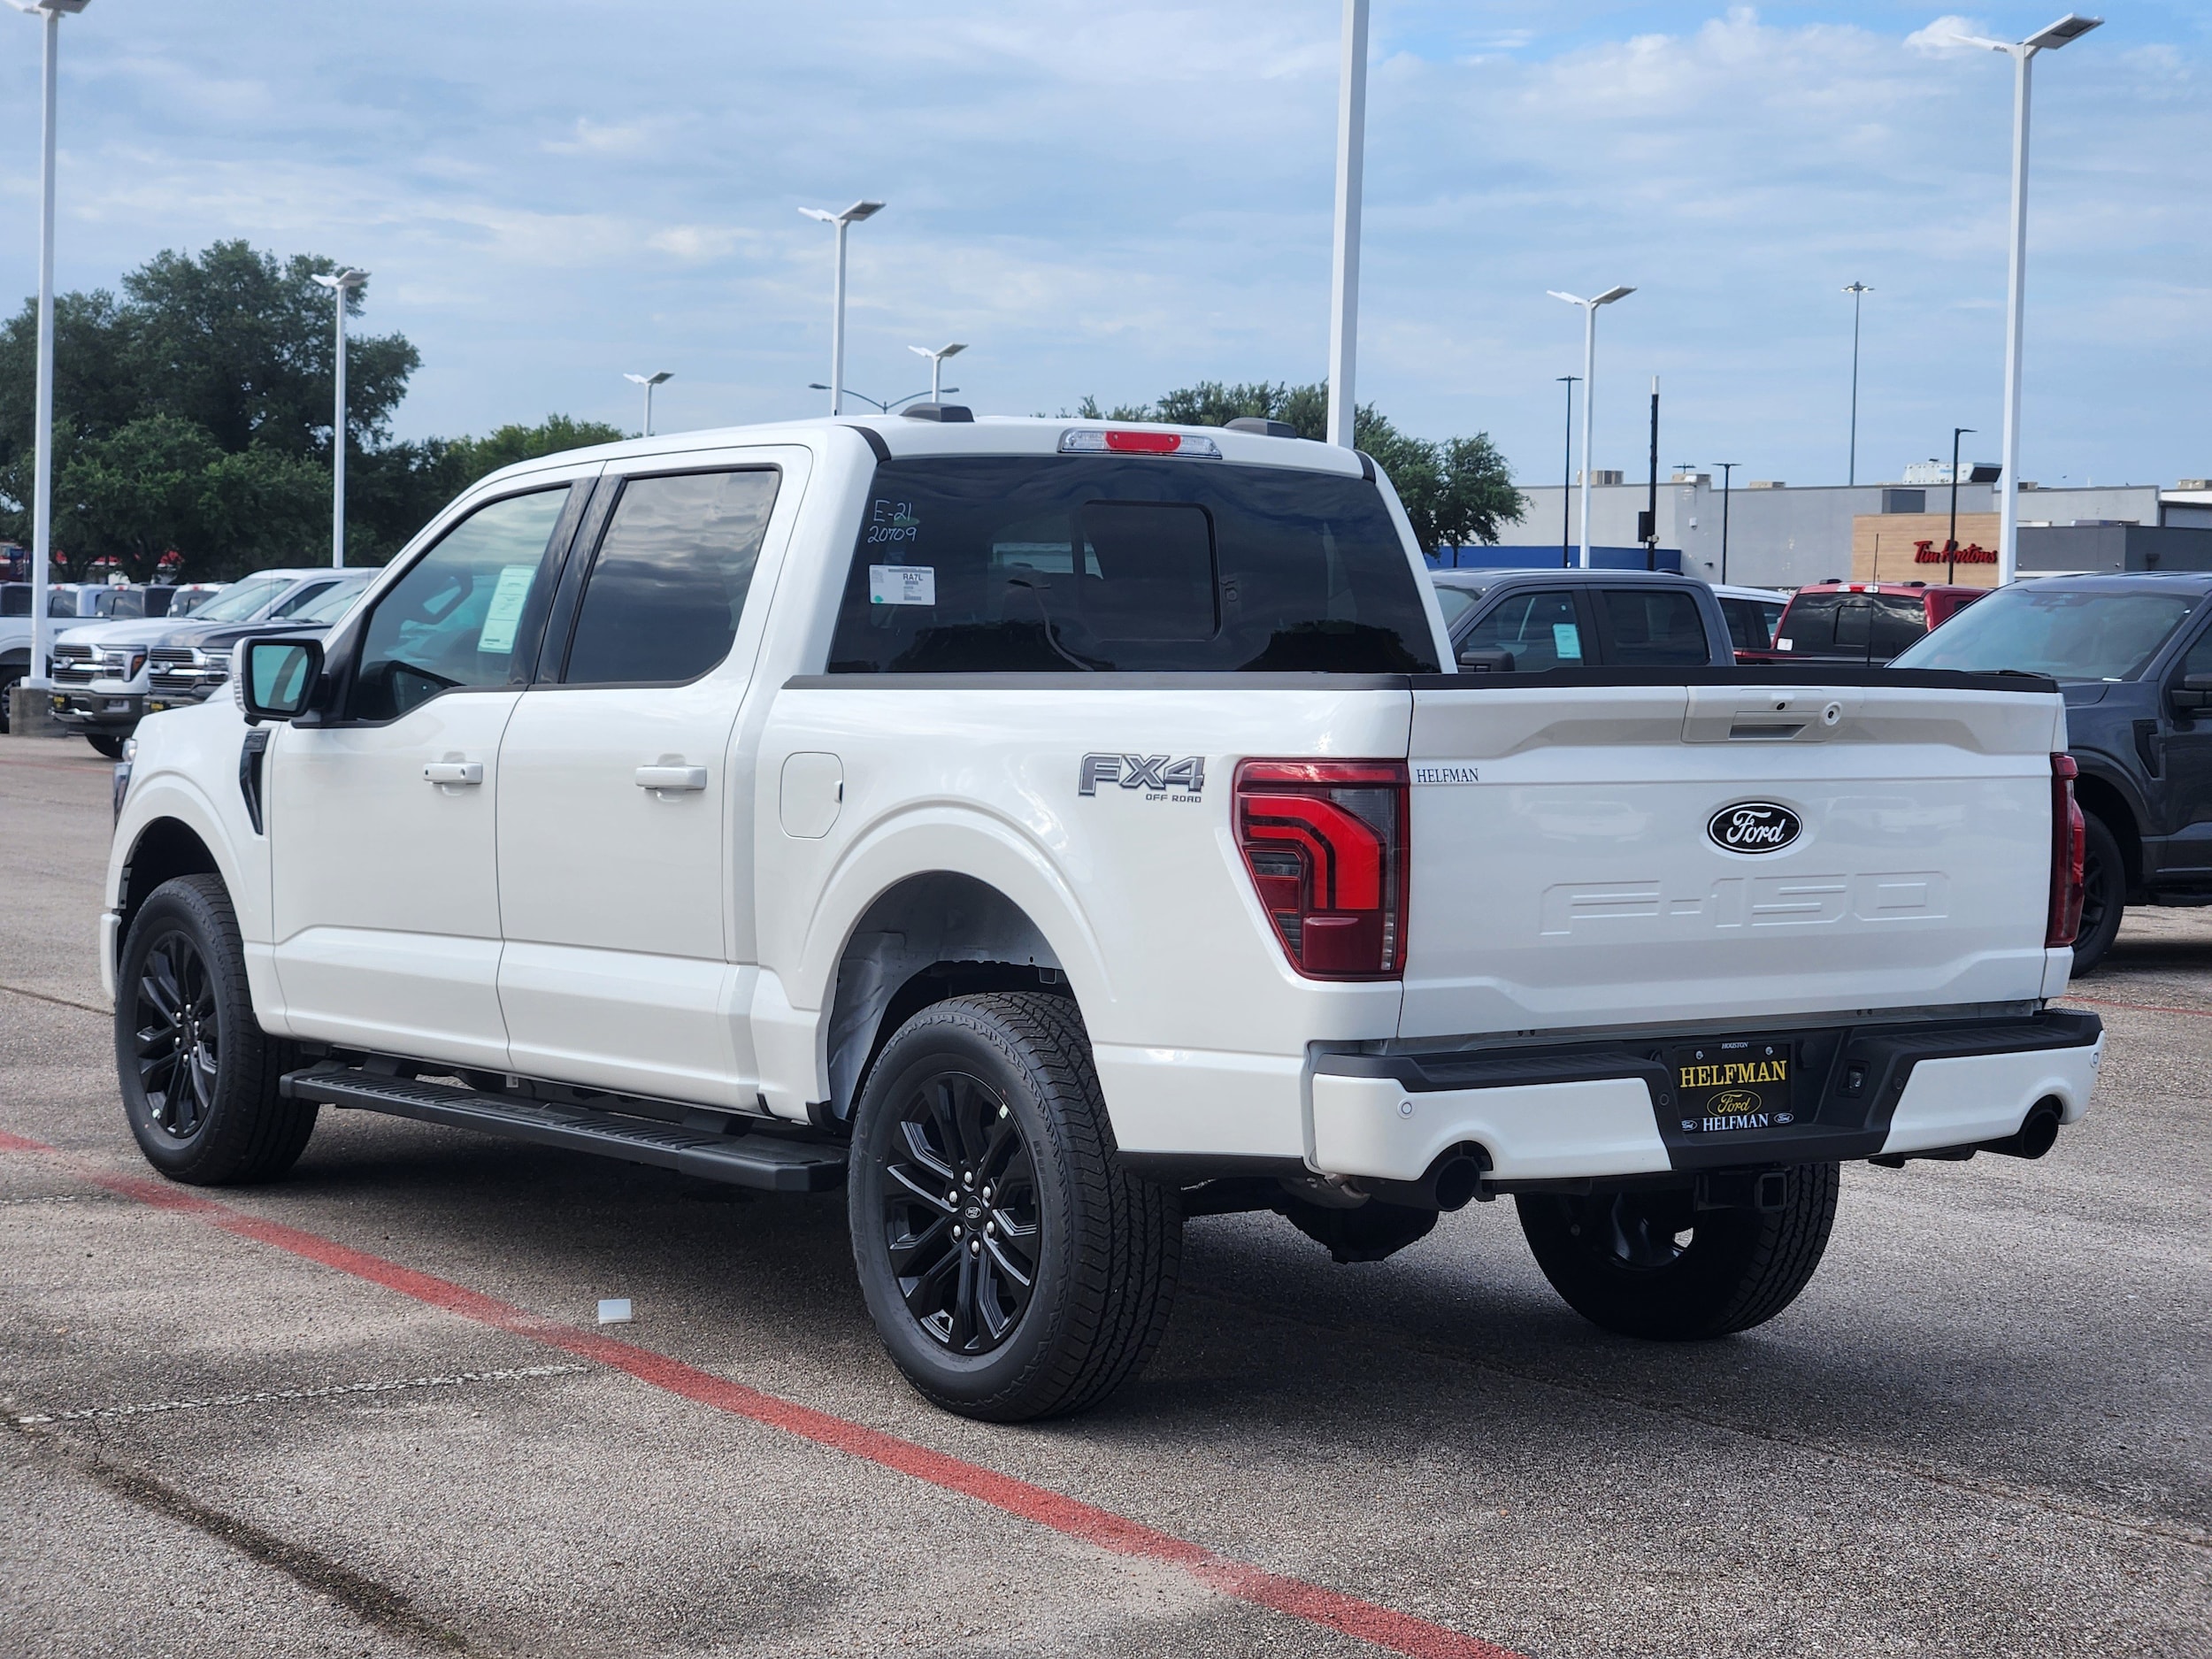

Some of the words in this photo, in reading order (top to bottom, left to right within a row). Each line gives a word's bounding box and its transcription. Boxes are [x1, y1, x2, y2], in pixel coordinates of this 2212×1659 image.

[873, 499, 912, 522] E-21
[867, 526, 918, 543] 20709
[1913, 541, 1941, 564] Tim
[902, 572, 924, 581] RA7L
[1078, 752, 1205, 796] FX4
[1416, 767, 1479, 783] HELFMAN
[1171, 795, 1202, 803] ROAD
[1725, 810, 1786, 843] Ford
[1540, 870, 1949, 935] F-150
[1679, 1060, 1787, 1088] HELFMAN
[1717, 1094, 1752, 1114] Ford
[1702, 1113, 1769, 1132] HELFMAN
